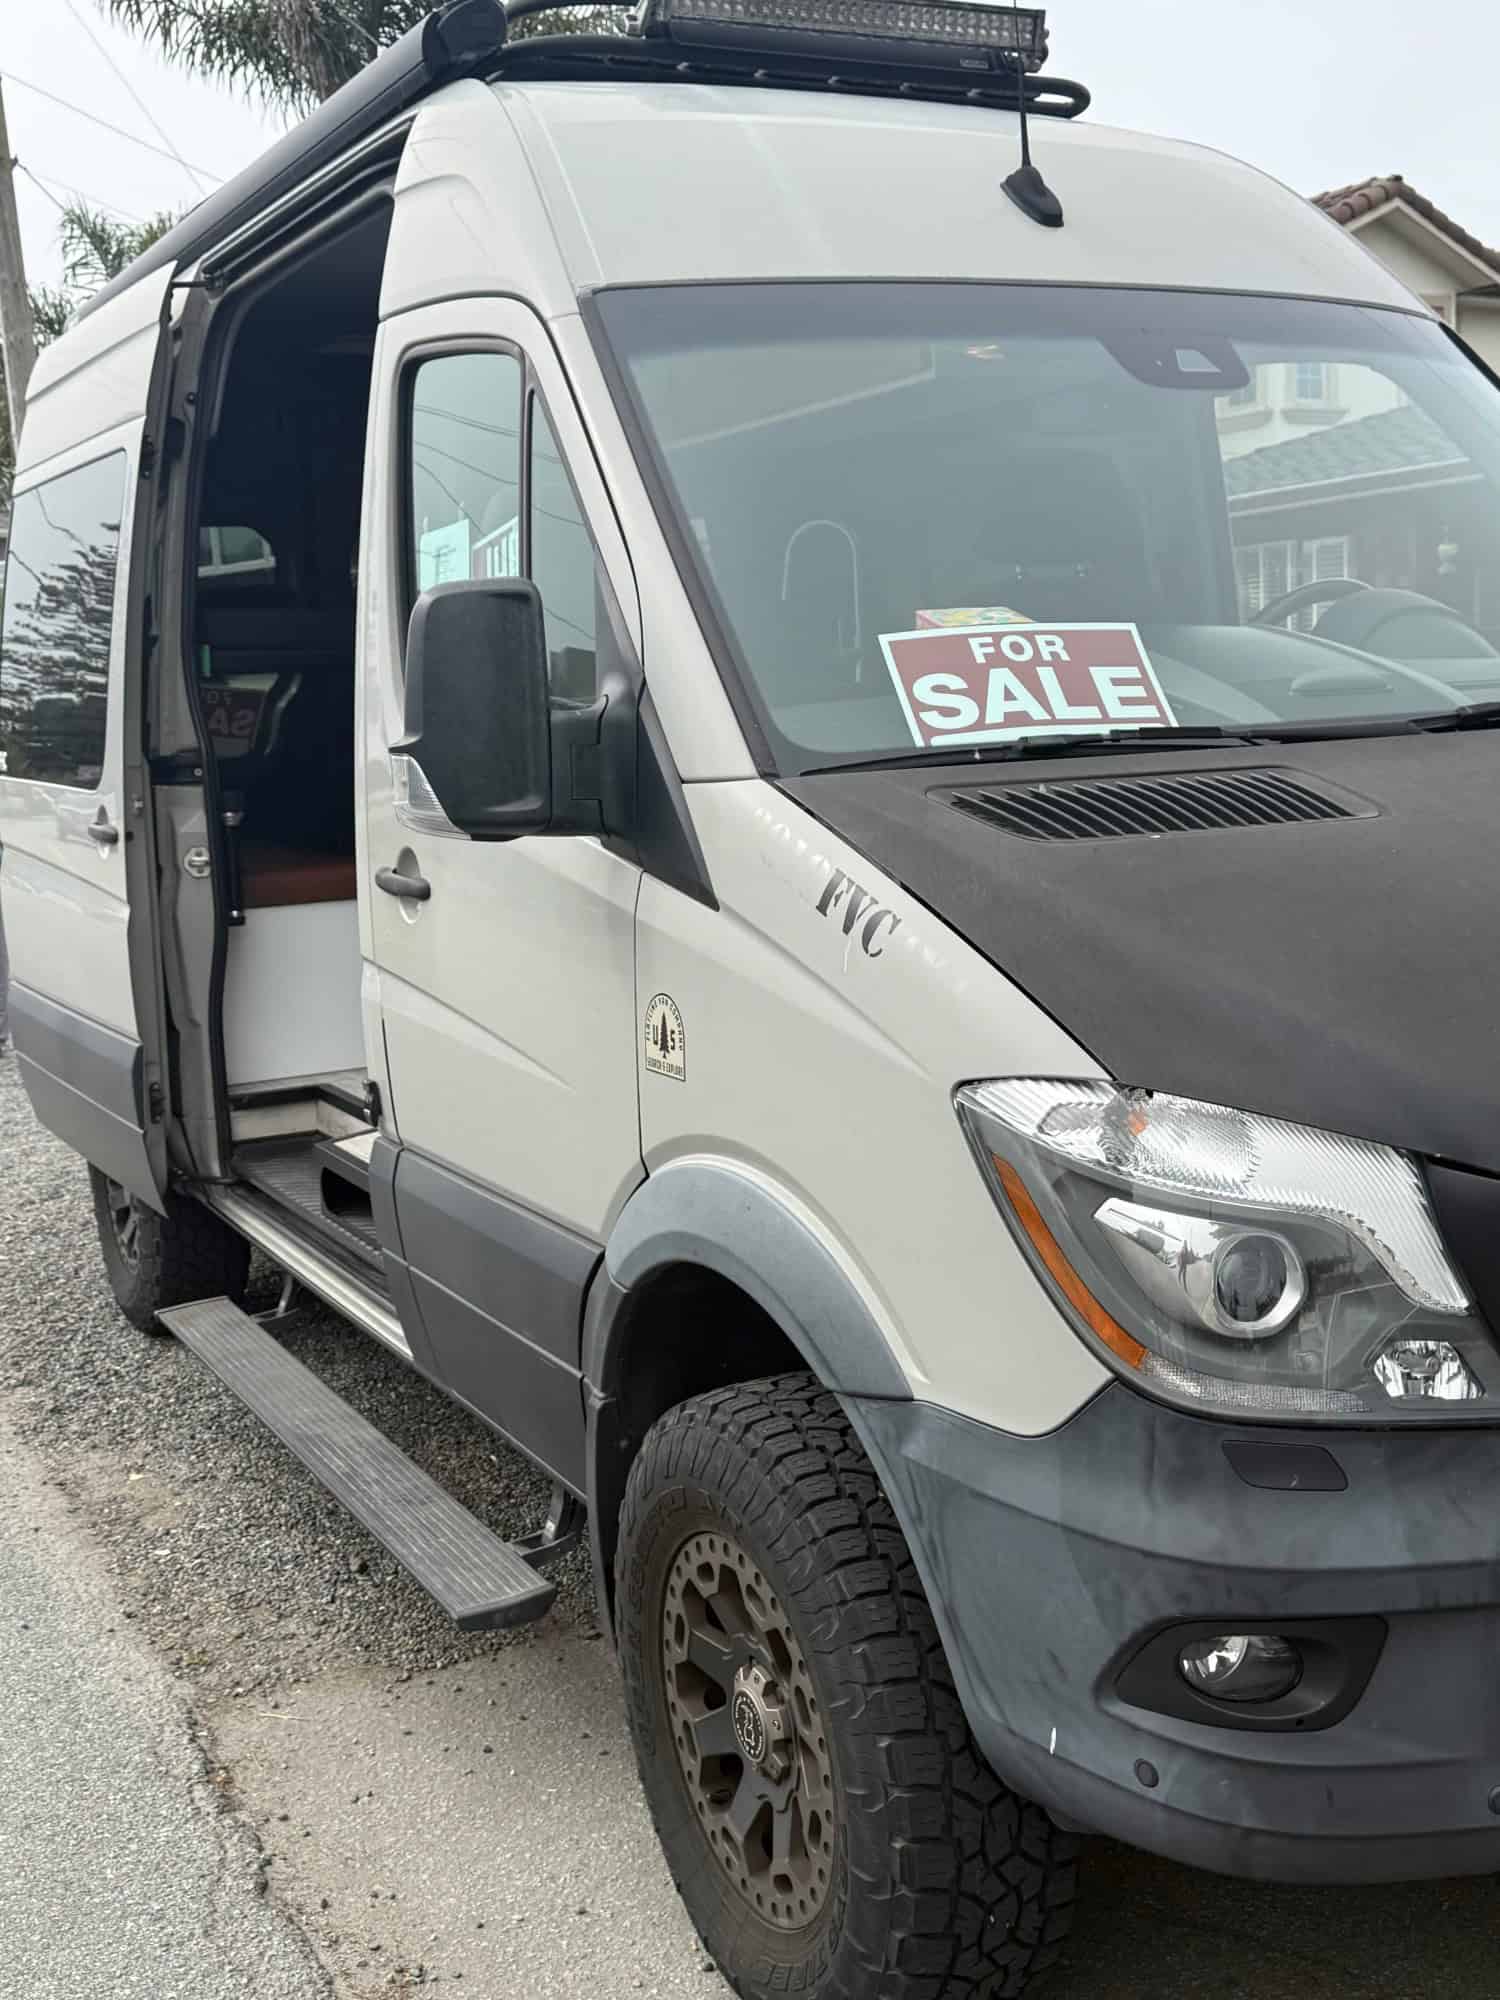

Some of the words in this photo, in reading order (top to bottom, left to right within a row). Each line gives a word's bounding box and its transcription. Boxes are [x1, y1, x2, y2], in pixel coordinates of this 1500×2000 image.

[968, 634, 1071, 664] FOR
[911, 665, 1161, 730] SALE
[816, 868, 902, 958] FVC
[652, 1023, 659, 1046] U
[670, 1029, 676, 1051] S
